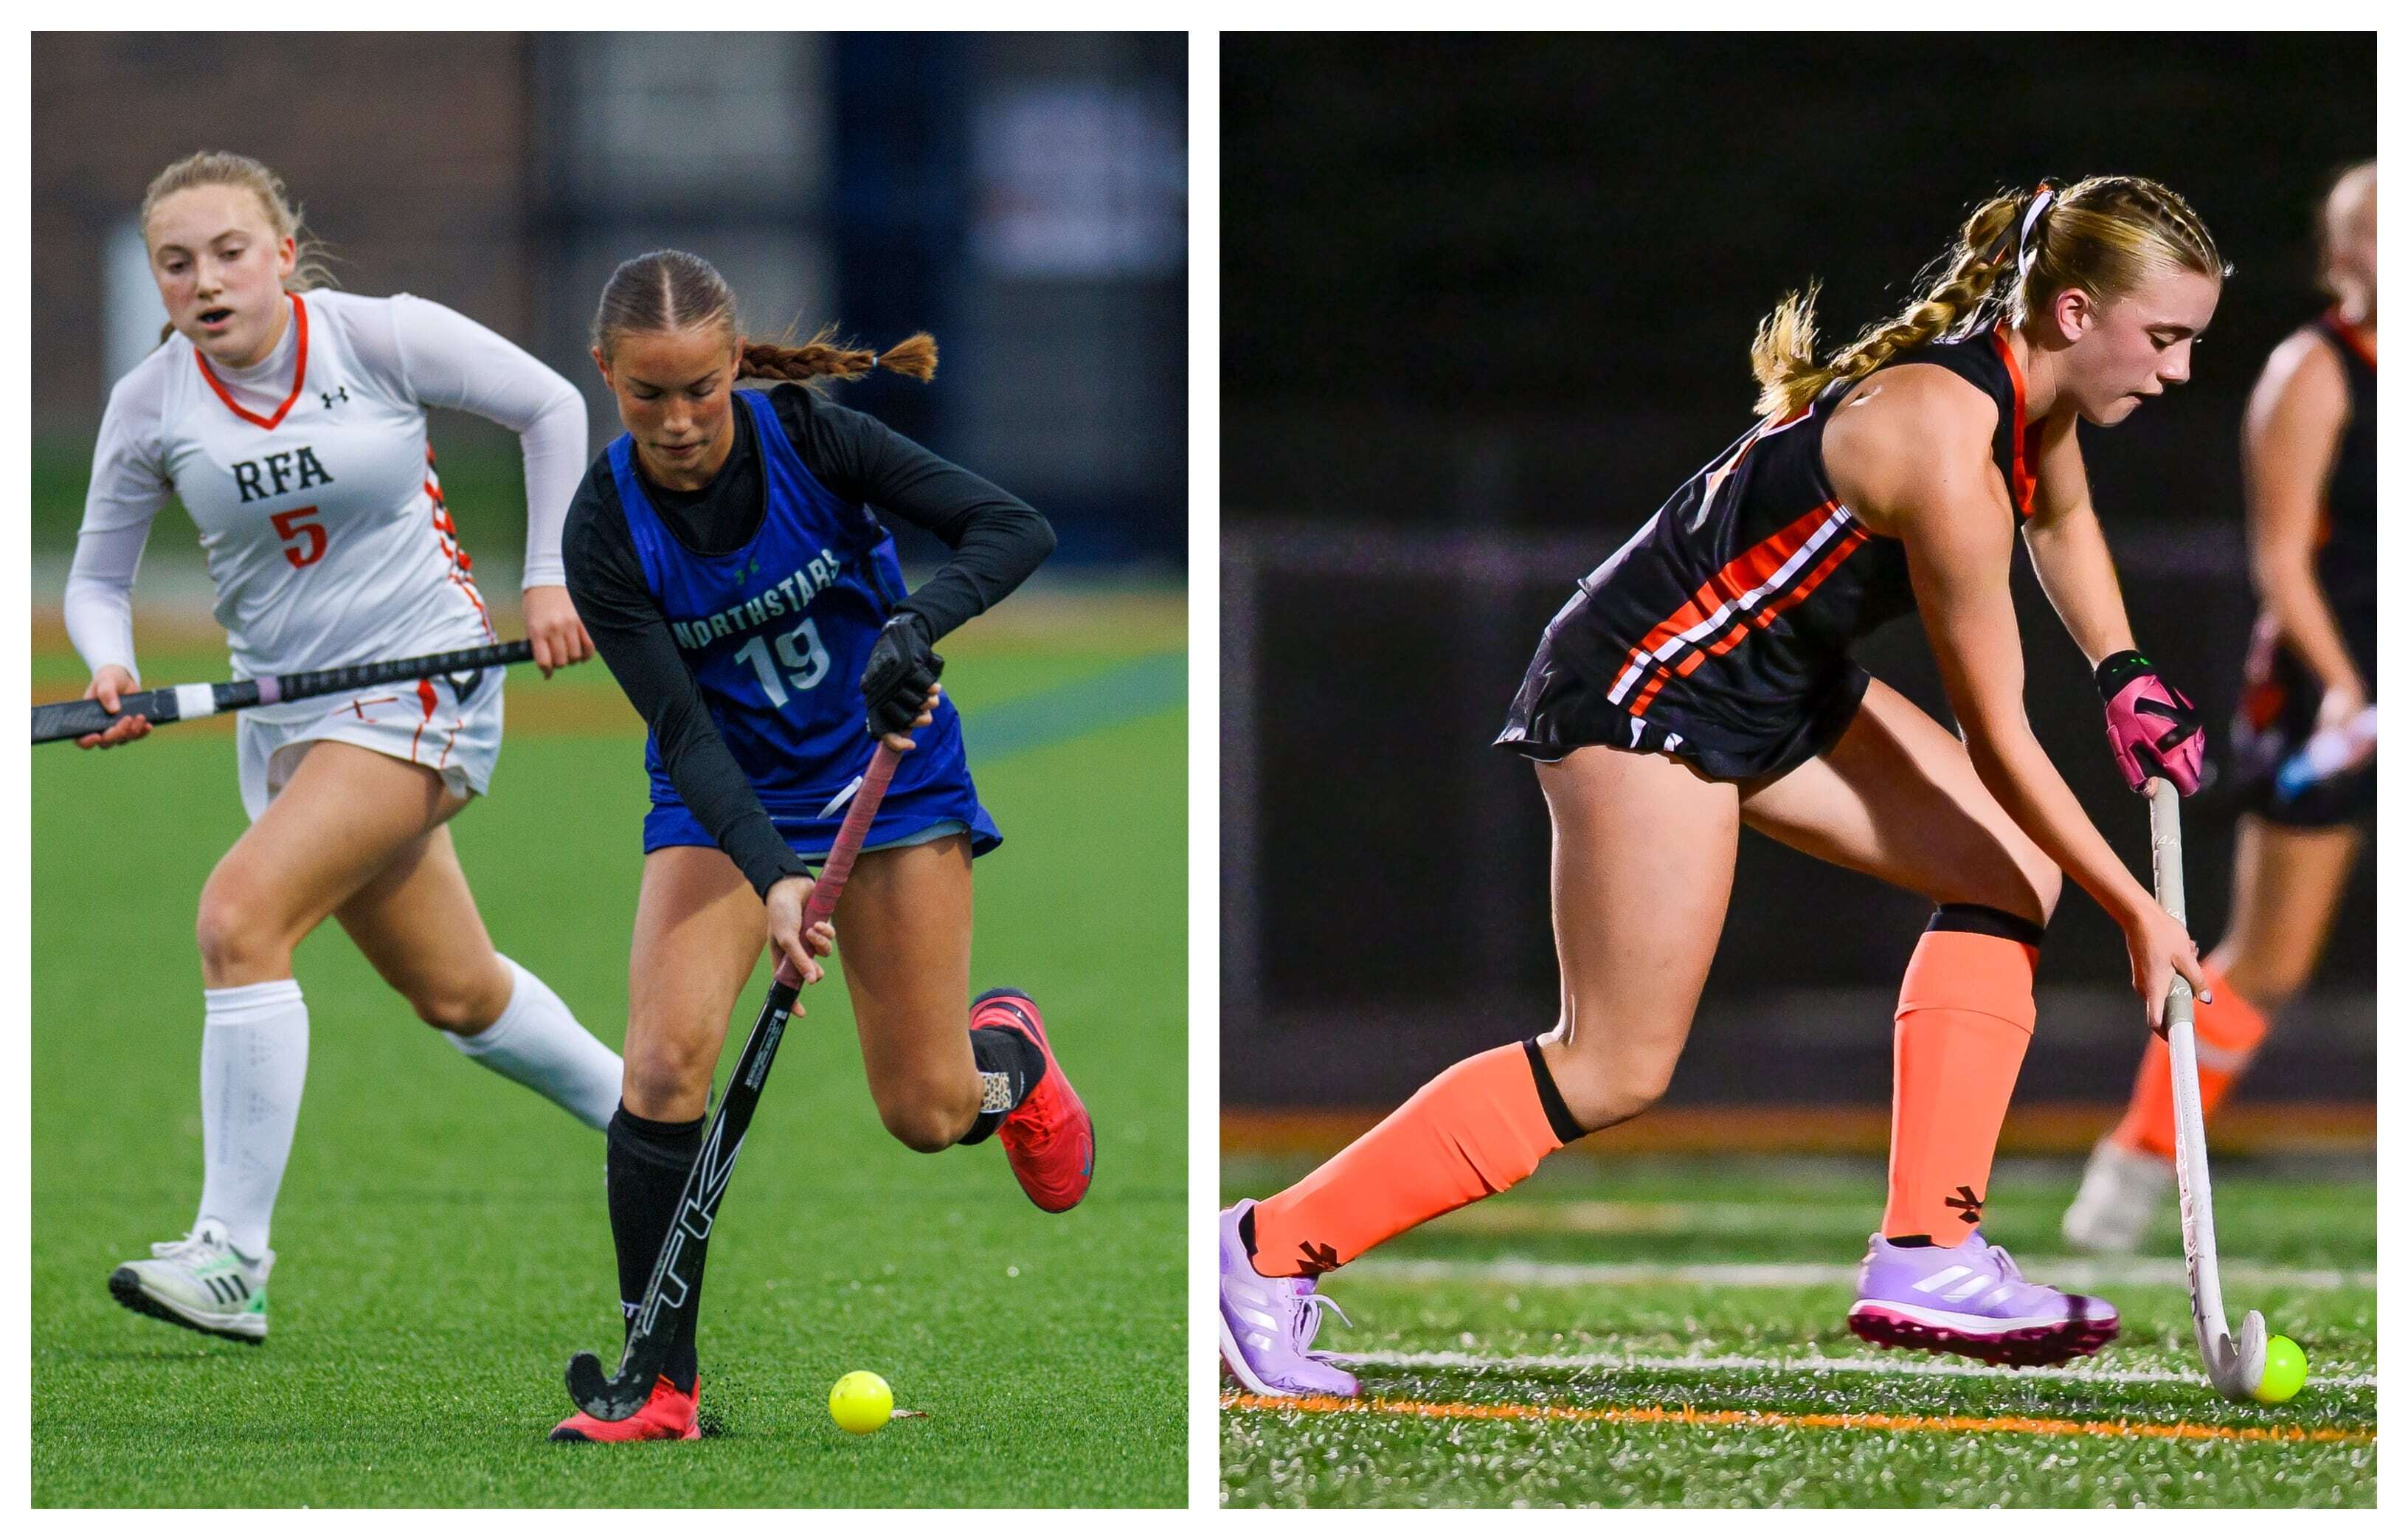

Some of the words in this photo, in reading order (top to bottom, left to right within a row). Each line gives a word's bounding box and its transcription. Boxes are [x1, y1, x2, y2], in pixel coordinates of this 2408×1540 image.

[231, 446, 335, 503] RFA
[269, 505, 328, 570] 5
[672, 548, 840, 649] NORTHSTARS
[734, 617, 830, 708] 19
[642, 1108, 748, 1336] TK
